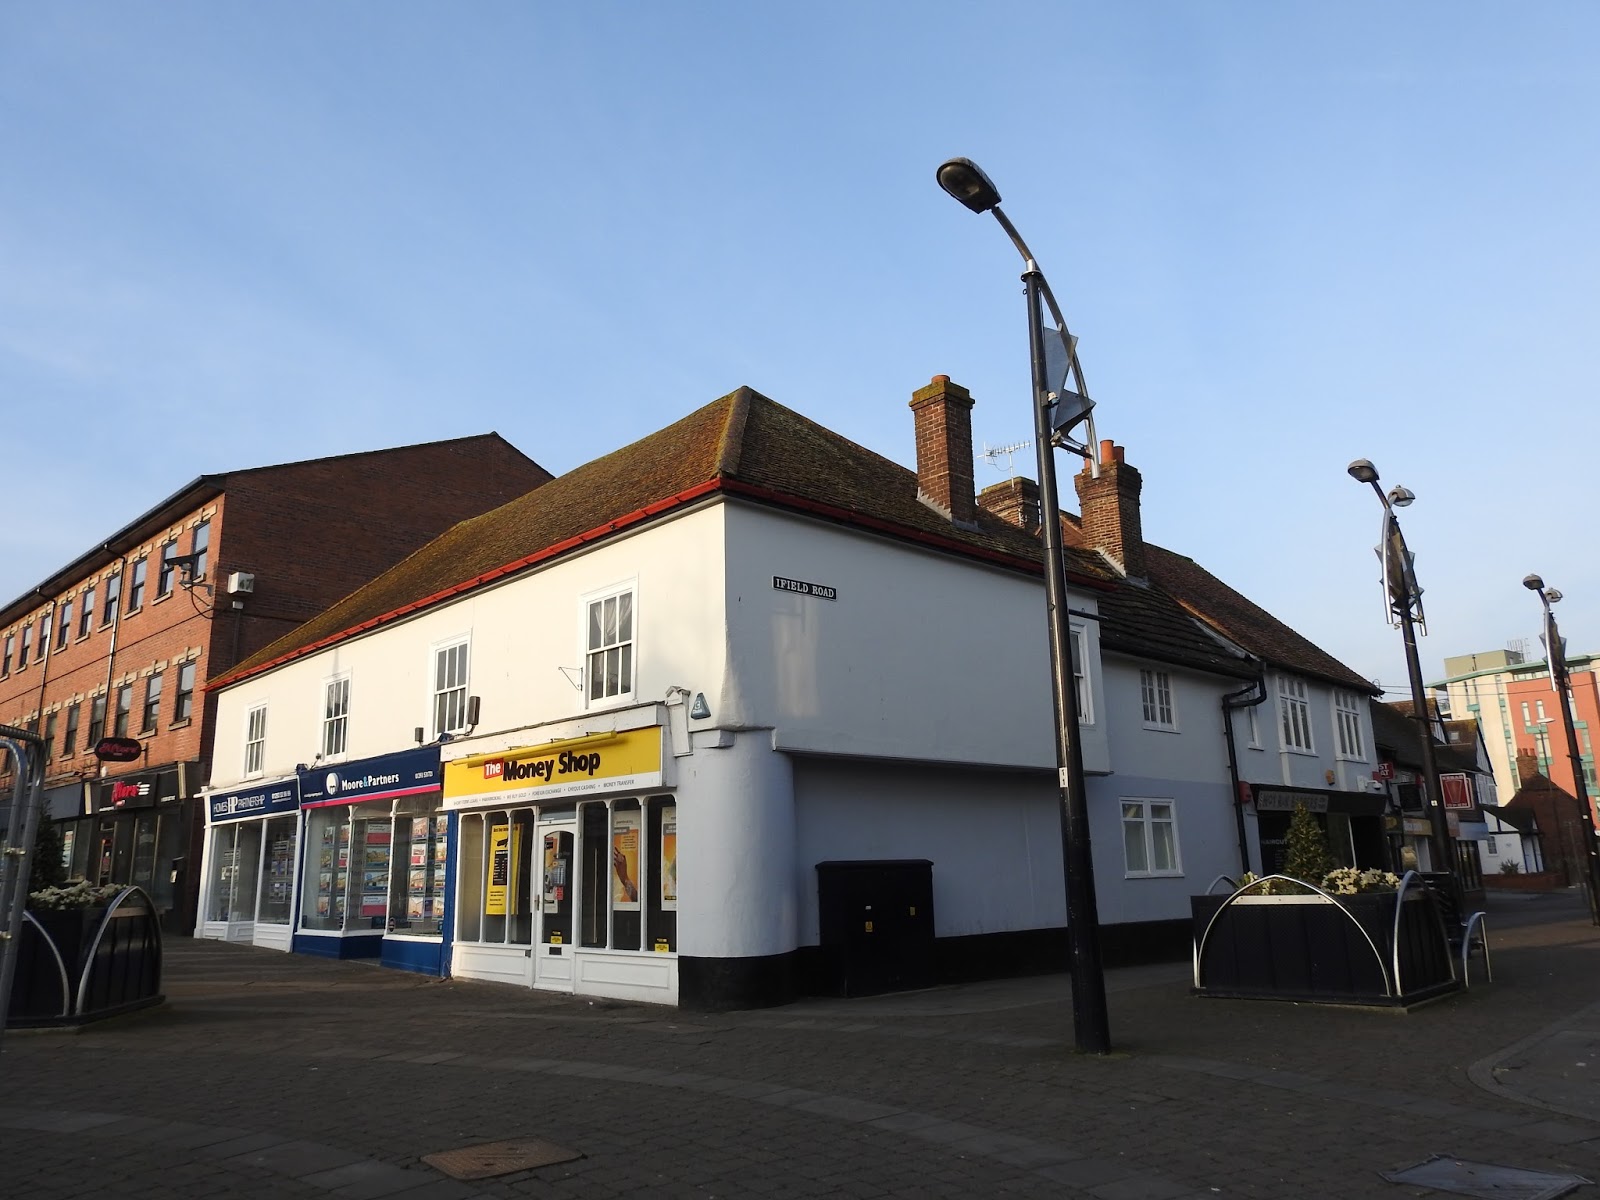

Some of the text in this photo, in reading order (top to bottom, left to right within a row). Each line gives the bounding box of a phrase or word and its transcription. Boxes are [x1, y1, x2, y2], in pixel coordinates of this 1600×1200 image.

[776, 578, 834, 598] IFIELD ROAD
[485, 750, 601, 782] The Money Shop
[341, 773, 400, 791] Moore&Partners
[617, 779, 635, 787] TRANSFER
